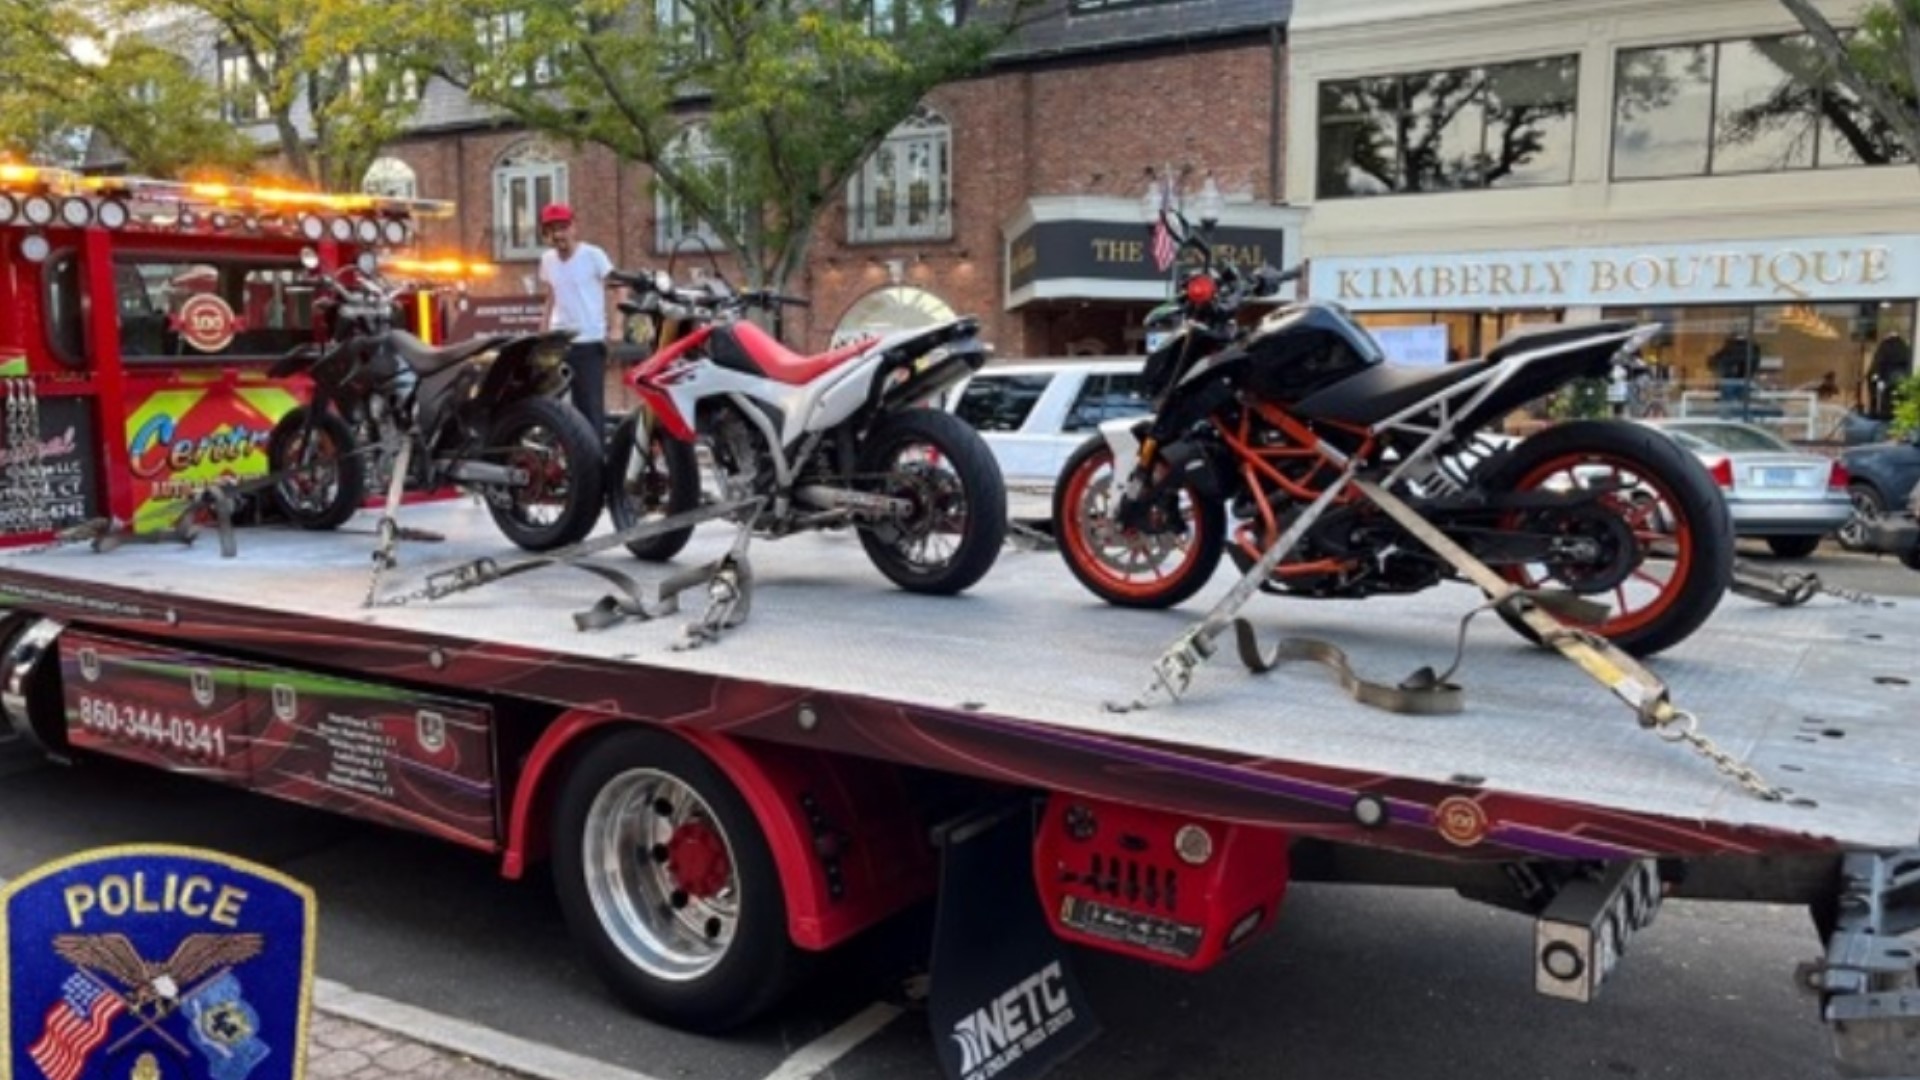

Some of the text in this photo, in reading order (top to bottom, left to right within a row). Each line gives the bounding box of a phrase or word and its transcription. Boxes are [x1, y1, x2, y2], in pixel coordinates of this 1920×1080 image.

[1091, 238, 1143, 263] THE
[1337, 246, 1888, 300] KIMBERLY BOUTIQUE
[79, 696, 226, 757] 860-344-0341
[974, 960, 1069, 1060] NETC
